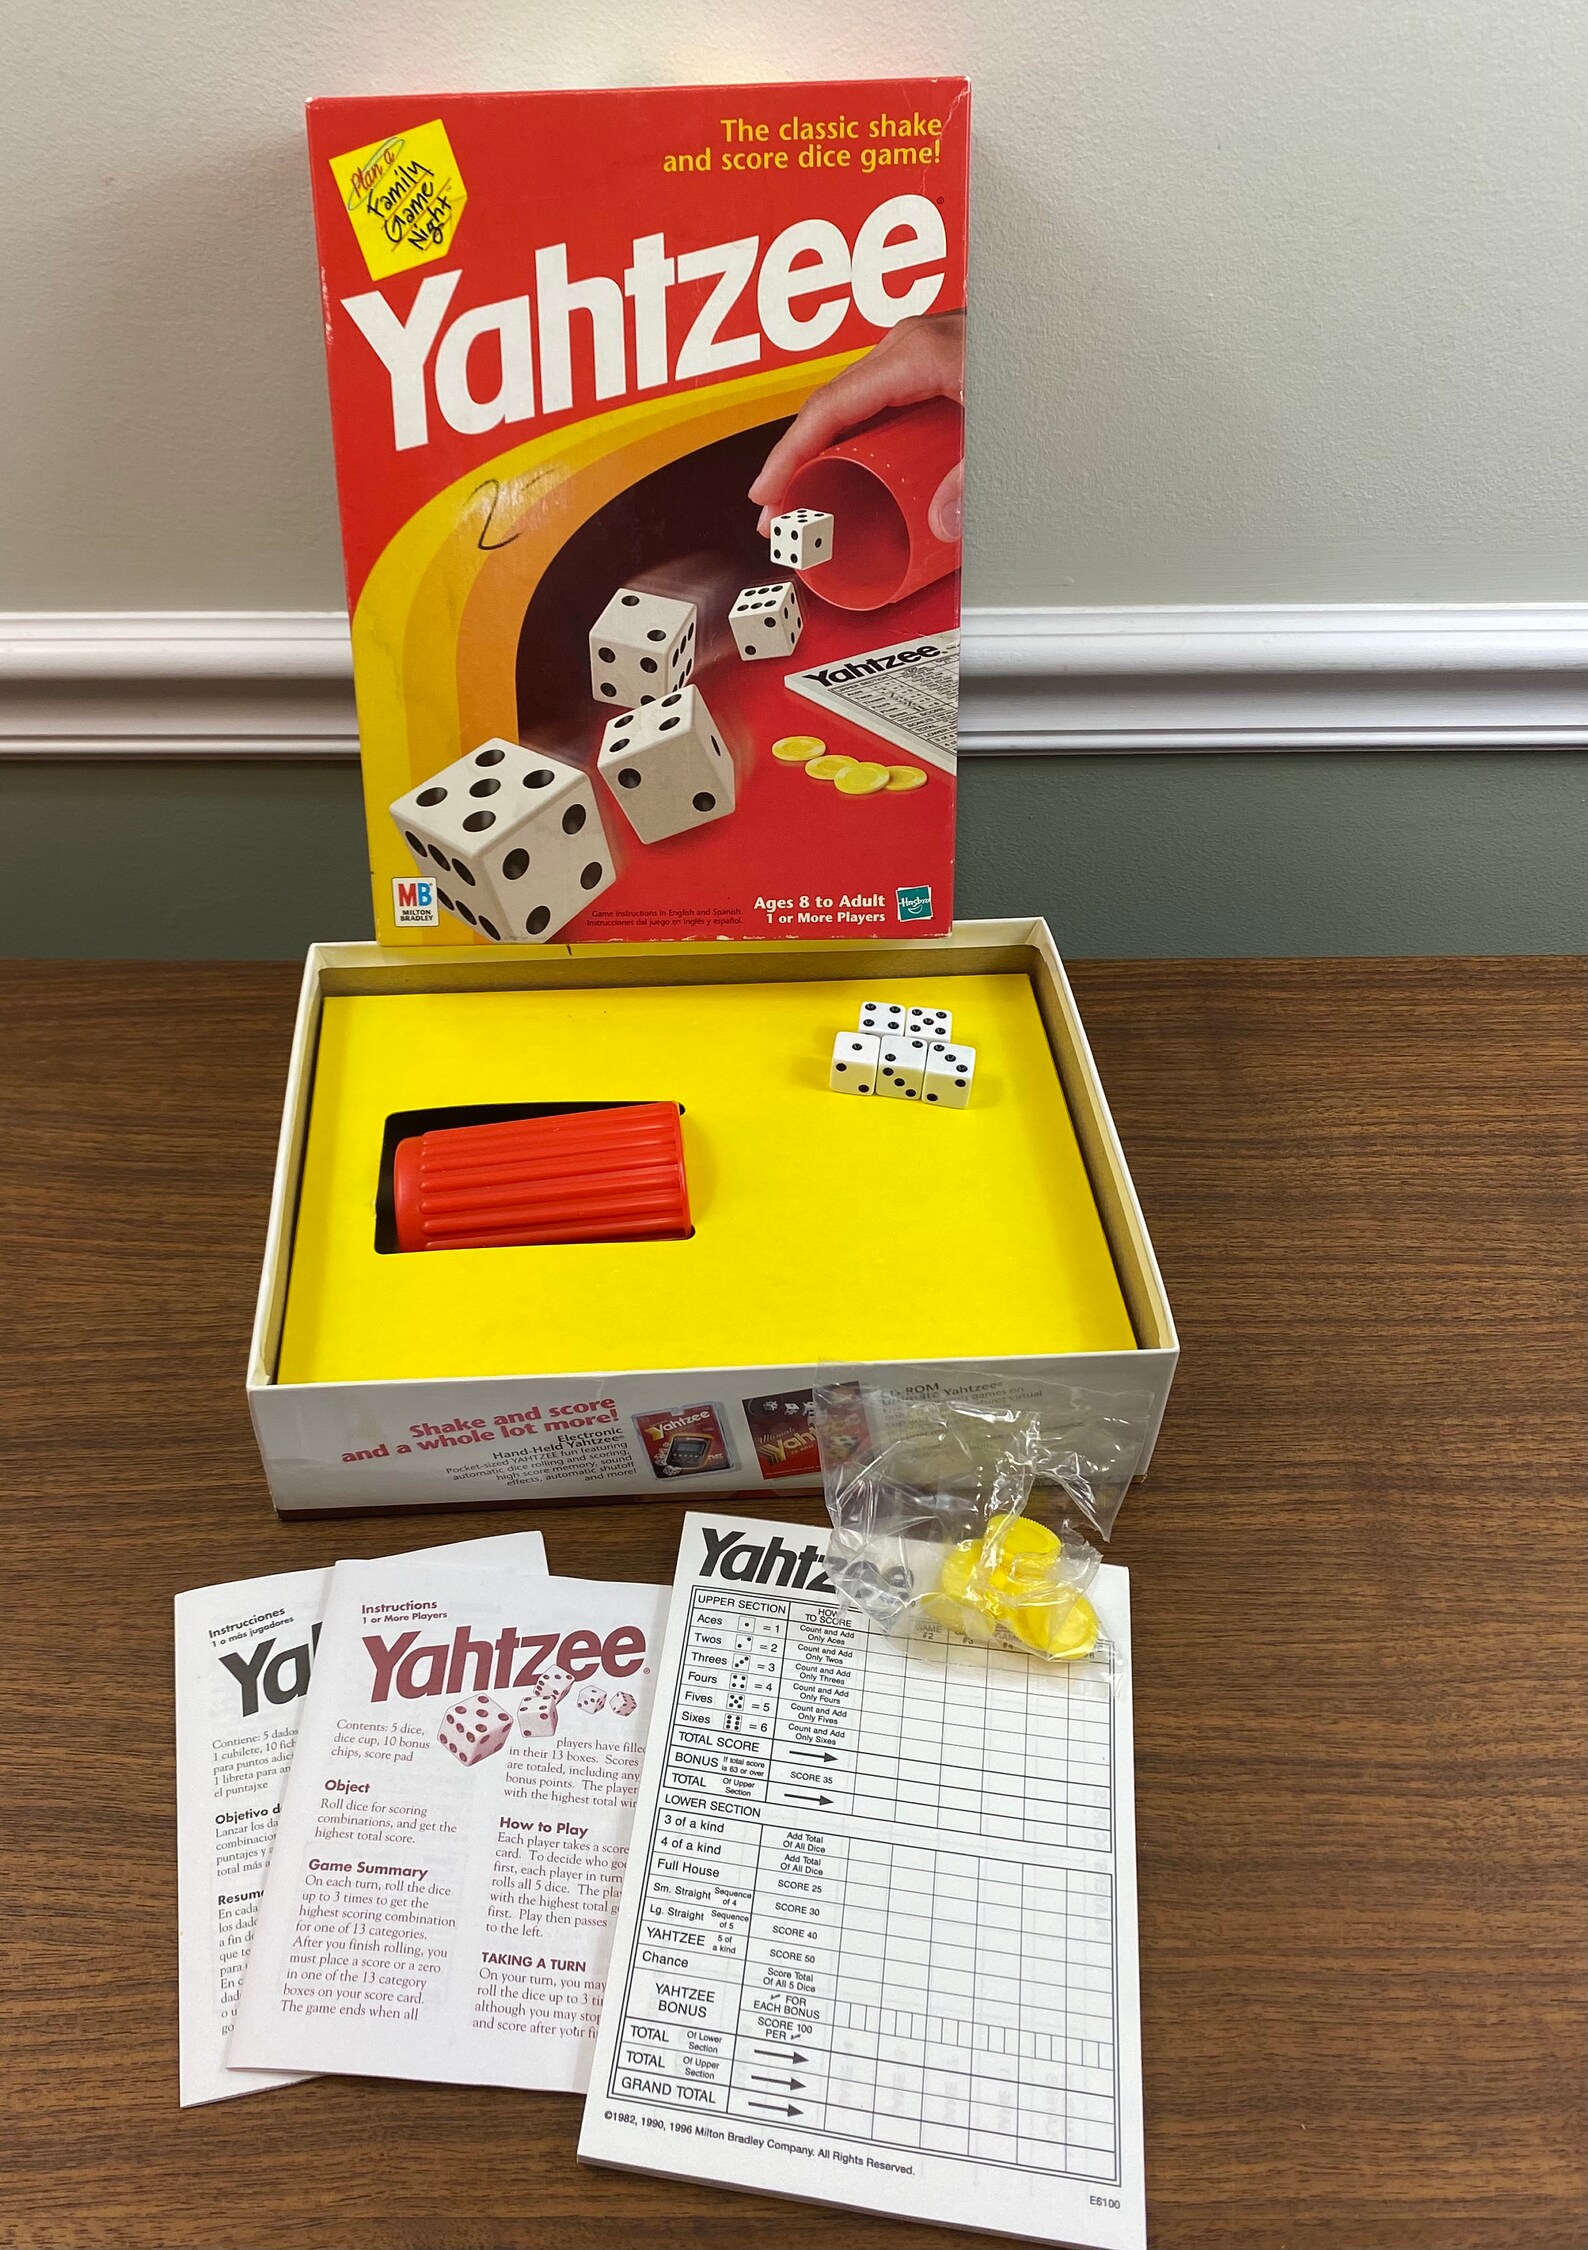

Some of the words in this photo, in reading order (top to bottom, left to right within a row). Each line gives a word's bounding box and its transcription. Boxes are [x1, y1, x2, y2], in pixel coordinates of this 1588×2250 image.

[720, 118, 769, 142] The
[778, 115, 859, 140] classic
[868, 112, 942, 137] shake
[663, 147, 711, 172] and
[721, 150, 789, 171] score
[798, 144, 851, 168] dice
[860, 140, 940, 173] game!
[351, 163, 382, 198] Plan
[384, 148, 394, 164] a
[367, 161, 434, 218] Family
[384, 182, 433, 243] Game
[407, 196, 451, 250] Night
[340, 194, 946, 451] Yahtzee
[802, 646, 940, 687] Yahtzee
[398, 883, 432, 907] MB
[754, 897, 793, 912] Ages
[799, 896, 809, 908] 8
[816, 896, 833, 908] to
[839, 894, 885, 908] Adult
[898, 896, 930, 908] Hasbro
[713, 909, 742, 917] Spanish.
[766, 914, 772, 923] 1
[779, 914, 793, 923] or
[798, 913, 832, 922] More
[837, 912, 885, 925] Players
[409, 1418, 486, 1438] Shake
[494, 1406, 542, 1425] and
[549, 1399, 615, 1417] score
[644, 1410, 710, 1440] Yahtzee
[342, 1444, 389, 1462] and
[397, 1444, 412, 1454] a
[417, 1430, 495, 1450] whole
[501, 1424, 538, 1438] lot
[544, 1409, 619, 1432] more!
[558, 1428, 622, 1442] Electronic
[446, 1460, 509, 1474] Pocket-sized
[511, 1450, 558, 1464] YAHTZEE
[581, 1443, 627, 1453] featuring
[493, 1443, 563, 1459] Hand-Held
[453, 1468, 505, 1480] automatic
[507, 1463, 528, 1472] dice
[531, 1459, 564, 1468] rolling
[567, 1455, 586, 1463] and
[589, 1450, 629, 1459] scoring,
[496, 1472, 520, 1480] high
[523, 1468, 549, 1476] score
[553, 1461, 597, 1471] memory,
[601, 1455, 632, 1464] sound
[507, 1476, 542, 1486] effects,
[546, 1468, 597, 1480] automatic
[600, 1462, 634, 1473] shutoff
[607, 1468, 637, 1478] more!
[362, 1600, 437, 1614] Instructions
[698, 1595, 735, 1608] UPPER
[738, 1600, 786, 1614] SECTION
[209, 1608, 285, 1638] Instrucciones
[412, 1612, 447, 1621] Players
[697, 1614, 722, 1625] Aces
[229, 1632, 247, 1642] más
[250, 1617, 294, 1637] jugadores
[695, 1633, 722, 1644] Twos
[361, 1625, 646, 1703] Yahtzee
[691, 1652, 727, 1665] Threes
[688, 1672, 717, 1684] Fours
[685, 1692, 713, 1704] Fives
[337, 1719, 388, 1732] Contents:
[391, 1723, 397, 1732] 5
[400, 1724, 425, 1735] dice,
[682, 1712, 711, 1724] Sixes
[212, 1736, 261, 1749] Contiene:
[264, 1731, 268, 1740] 5
[271, 1728, 299, 1738] dados
[334, 1732, 355, 1743] dice
[358, 1736, 379, 1746] cup,
[384, 1736, 396, 1746] 10
[399, 1737, 430, 1748] bonus
[679, 1731, 713, 1746] TOTAL
[717, 1734, 759, 1752] SCORE
[675, 1752, 719, 1767] BONUS
[790, 1771, 820, 1782] SCORE
[823, 1776, 833, 1784] 35
[325, 1779, 370, 1794] Object
[665, 1794, 706, 1809] LOWER
[710, 1801, 760, 1817] SECTION
[215, 1808, 268, 1824] Objetivo
[664, 1815, 672, 1824] 3
[675, 1817, 686, 1826] of
[690, 1821, 697, 1829] a
[701, 1820, 724, 1832] kind
[500, 1817, 534, 1830] How
[538, 1822, 552, 1832] to
[557, 1822, 588, 1839] Play
[309, 1859, 352, 1872] Game
[357, 1861, 428, 1881] Summary
[658, 1859, 679, 1871] Full
[682, 1862, 720, 1878] House
[778, 1880, 809, 1891] SCORE
[812, 1884, 822, 1893] 25
[653, 1883, 671, 1894] Sm.
[675, 1886, 711, 1900] Straight
[647, 1927, 705, 1946] YAHTZEE
[482, 1952, 532, 1967] TAKING
[537, 1958, 546, 1968] A
[550, 1959, 586, 1972] TURN
[642, 1951, 688, 1968] Chance
[770, 1949, 802, 1961] SCORE
[804, 1955, 815, 1964] 50
[655, 1983, 715, 2003] YAHTZEE
[658, 2001, 707, 2018] BONUS
[631, 2025, 669, 2042] TOTAL
[687, 2031, 697, 2039] Of
[699, 2032, 722, 2044] Lower
[689, 2042, 718, 2054] Section
[621, 2077, 671, 2096] GRAND
[677, 2086, 716, 2103] TOTAL
[641, 2117, 667, 2131] 1990,
[670, 2123, 692, 2135] 1996
[695, 2127, 724, 2140] Milton
[728, 2133, 764, 2148] Bradley
[767, 2140, 814, 2157] Company.
[817, 2148, 831, 2159] All
[833, 2150, 864, 2168] Rights
[866, 2158, 916, 2176] Reserved.
[1089, 2194, 1121, 2210] E6100
